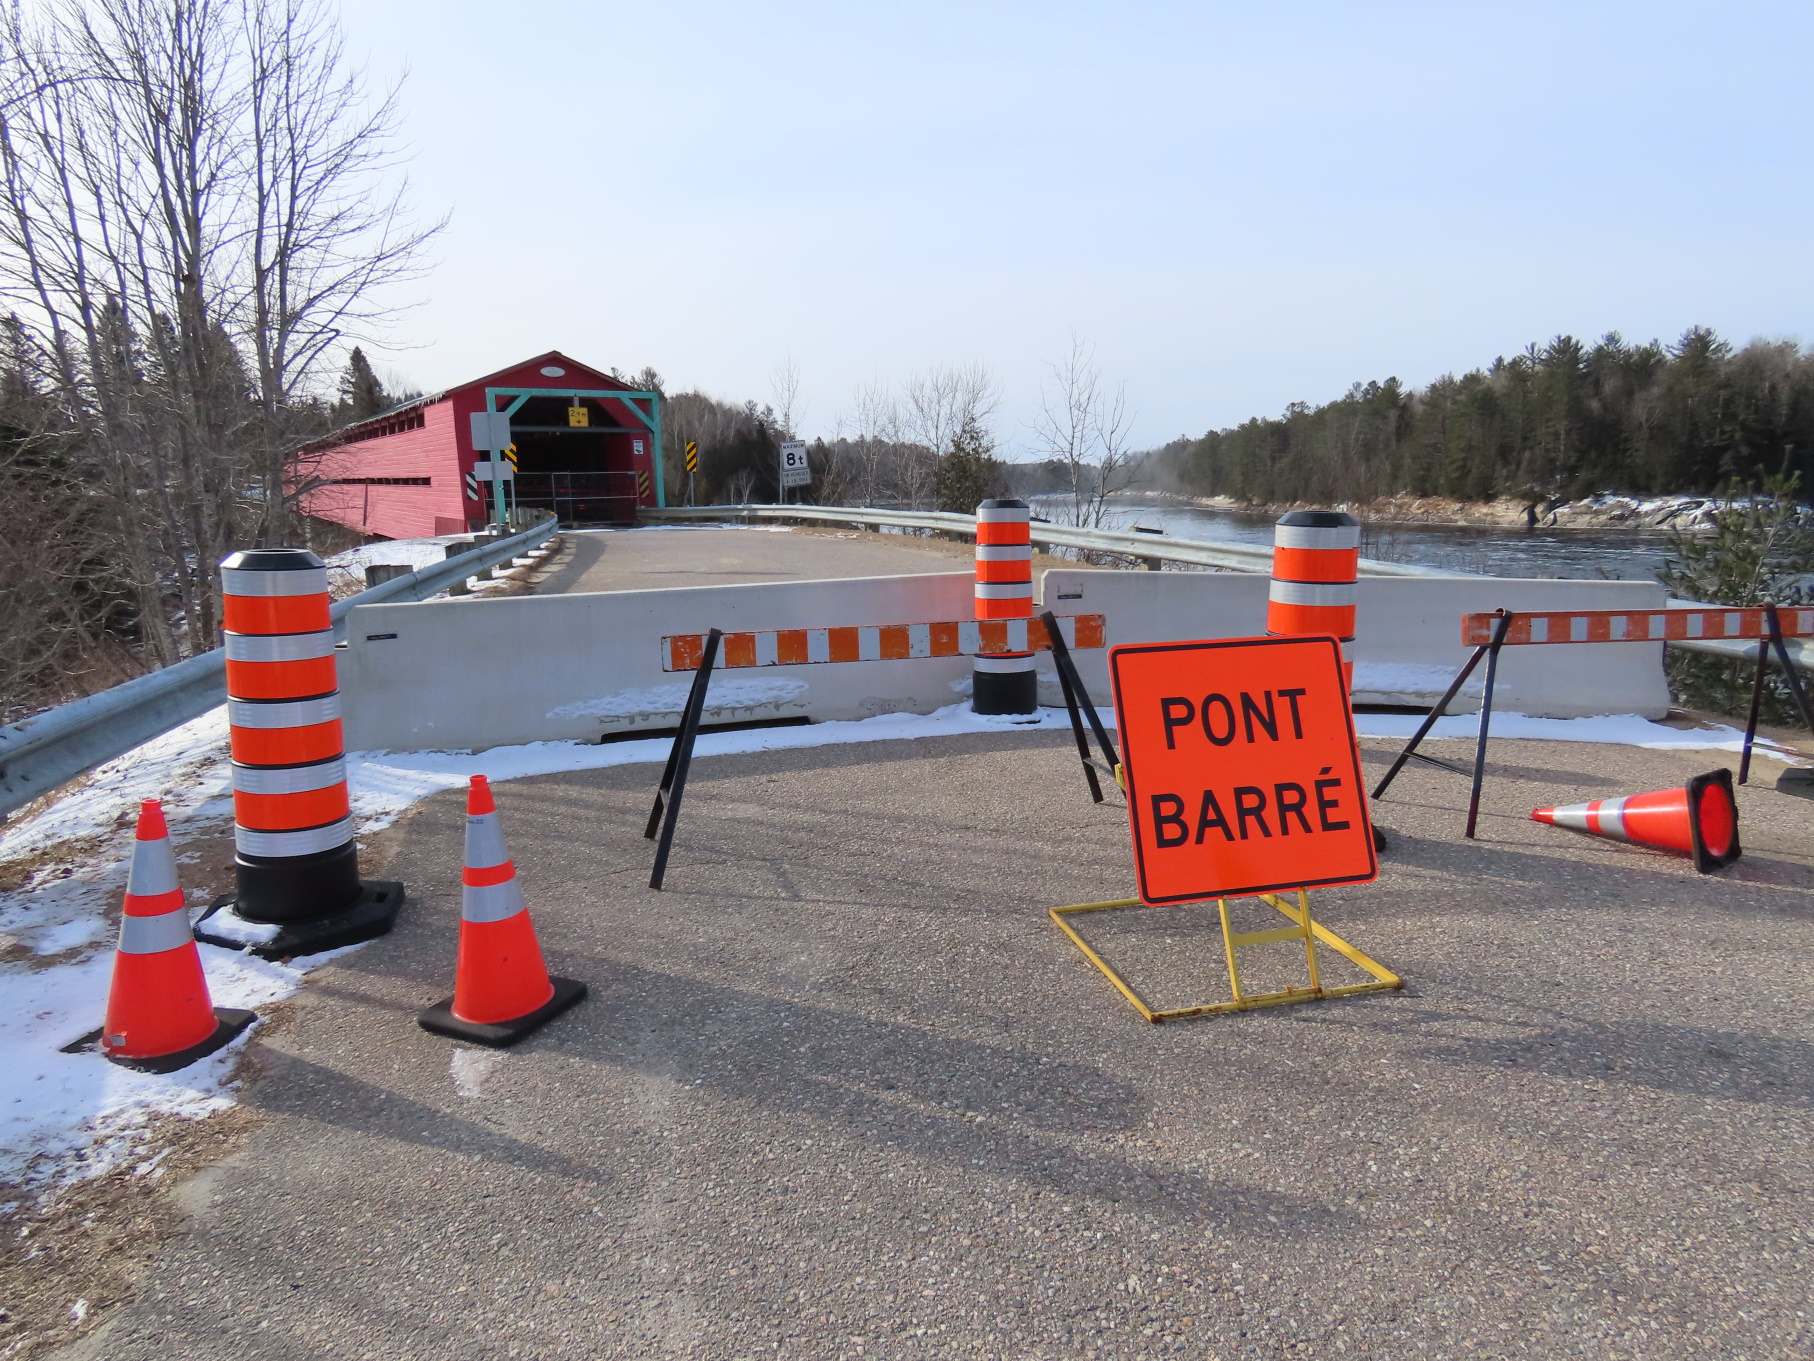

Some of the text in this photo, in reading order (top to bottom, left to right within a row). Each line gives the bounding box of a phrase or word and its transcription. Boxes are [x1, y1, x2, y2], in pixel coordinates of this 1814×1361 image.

[787, 453, 804, 466] 8 t
[1160, 688, 1306, 750] PONT
[1151, 767, 1350, 848] BARRÉ
